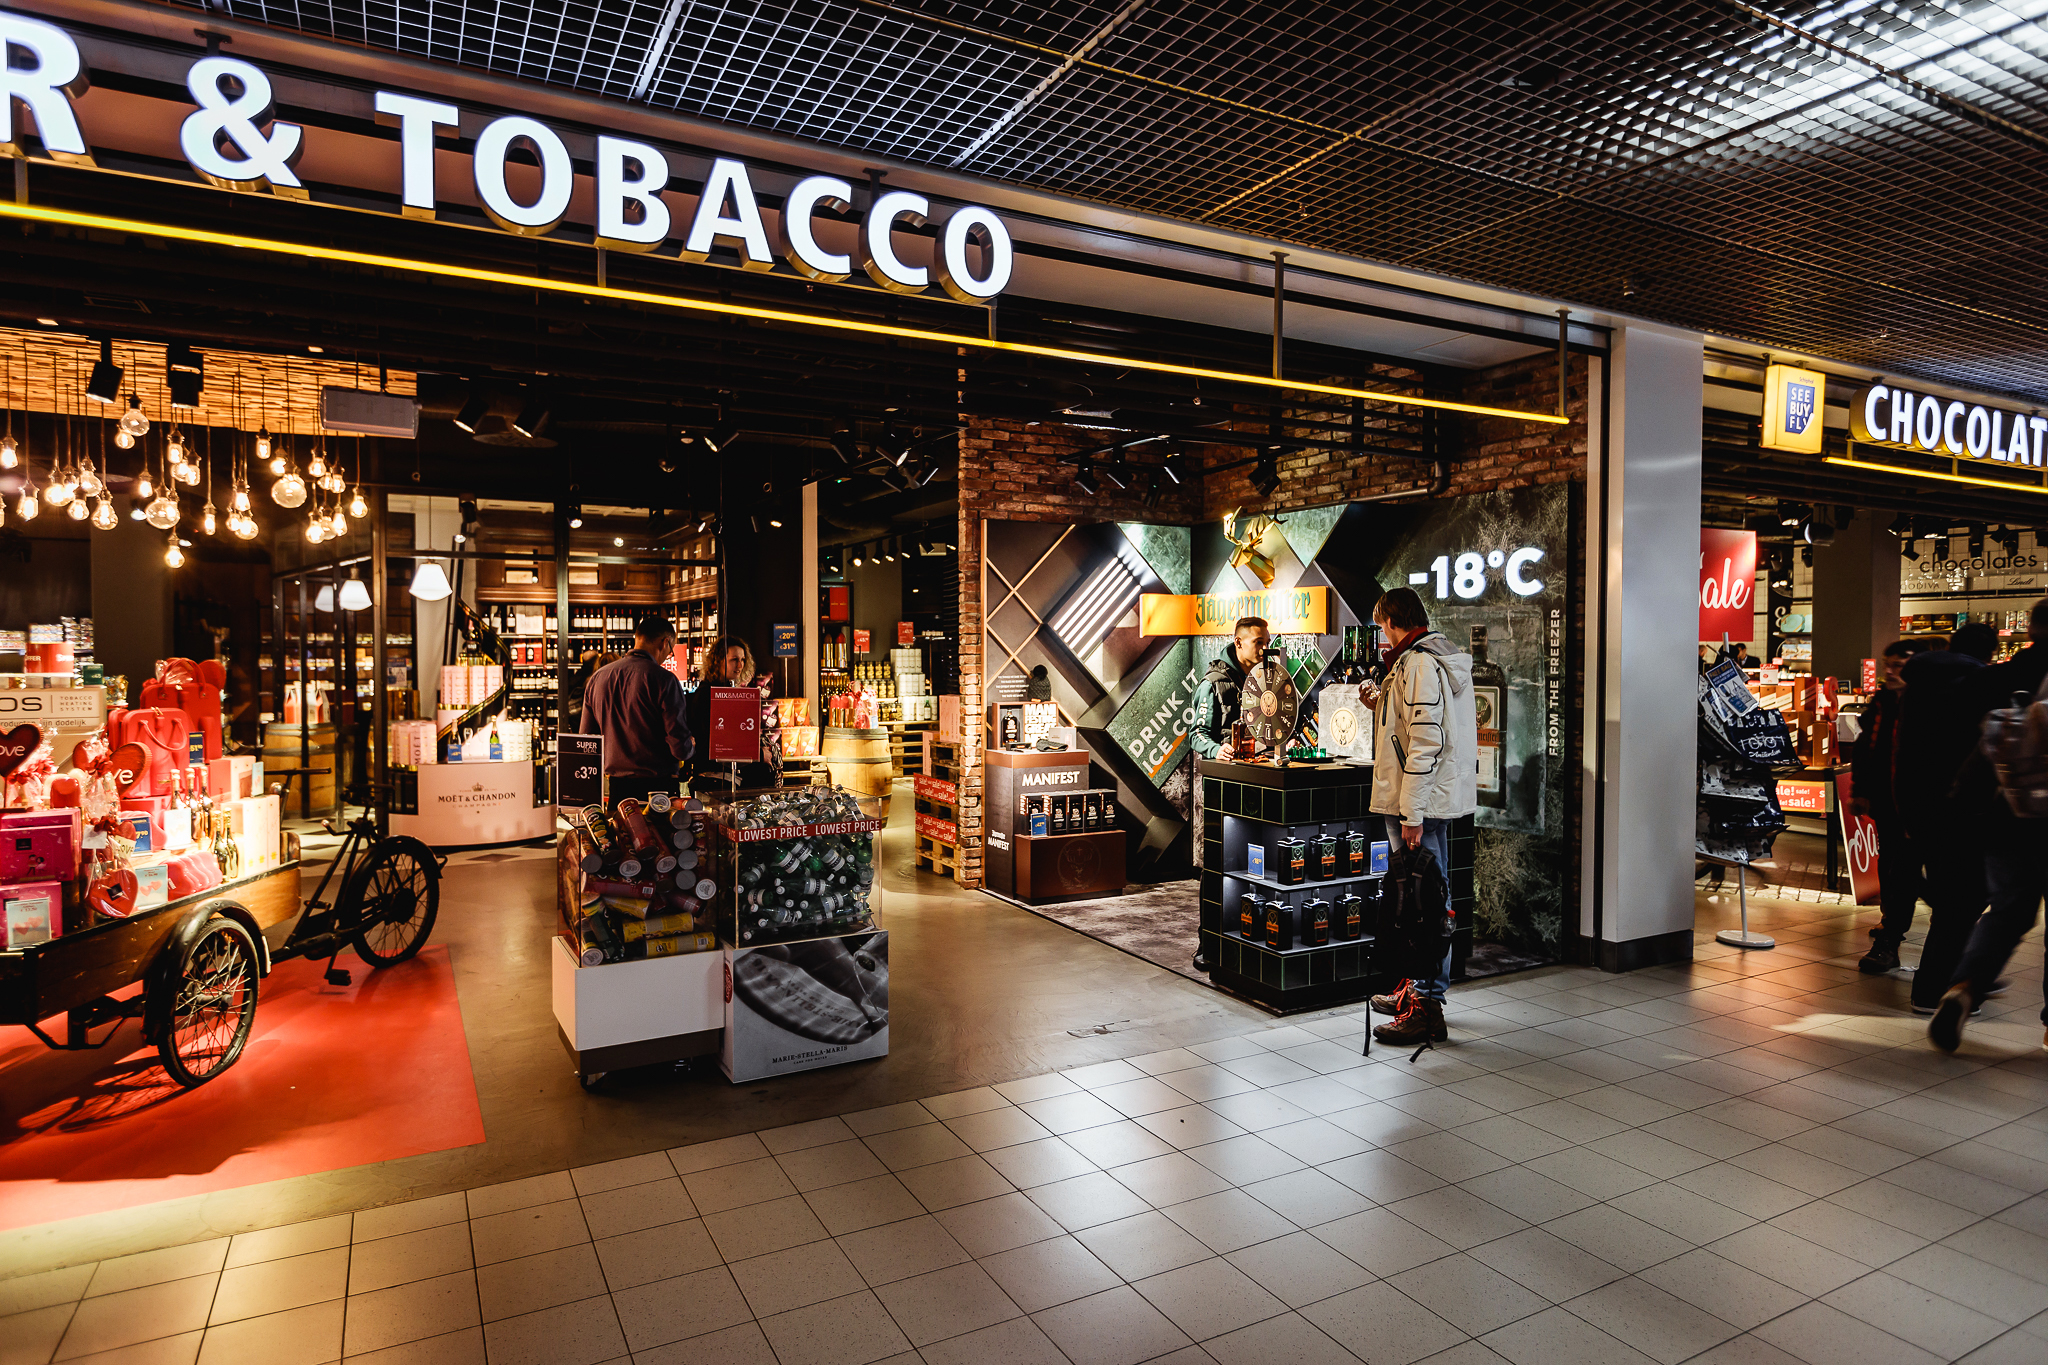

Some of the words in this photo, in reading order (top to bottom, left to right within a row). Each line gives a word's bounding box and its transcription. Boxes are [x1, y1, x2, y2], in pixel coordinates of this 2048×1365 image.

[0, 12, 87, 154] R
[180, 57, 302, 188] &
[375, 91, 1014, 298] TOBACCO
[1791, 387, 1811, 403] SEE
[1790, 401, 1811, 417] BUY
[1864, 385, 2048, 467] CHOCOLAT
[1409, 547, 1545, 599] -18°C
[1699, 557, 1751, 610] ale
[1550, 609, 1561, 675] FREEZER
[1550, 677, 1559, 709] THE
[56, 719, 87, 727] dodelijk
[718, 718, 724, 727] 2
[1128, 690, 1184, 758] DRINK
[1181, 667, 1200, 693] IT
[740, 718, 755, 730] €3
[1549, 713, 1559, 756] FROM
[576, 741, 598, 749] SUPER
[1142, 737, 1174, 775] ICE
[1021, 771, 1080, 786] MANIFEST
[438, 794, 463, 803] MOËT
[472, 792, 516, 802] CHANDON
[1788, 798, 1815, 808] sale!
[738, 829, 776, 842] LOWEST
[780, 826, 808, 838] PRICE
[815, 822, 851, 835] LOWEST
[854, 820, 880, 832] PRICE
